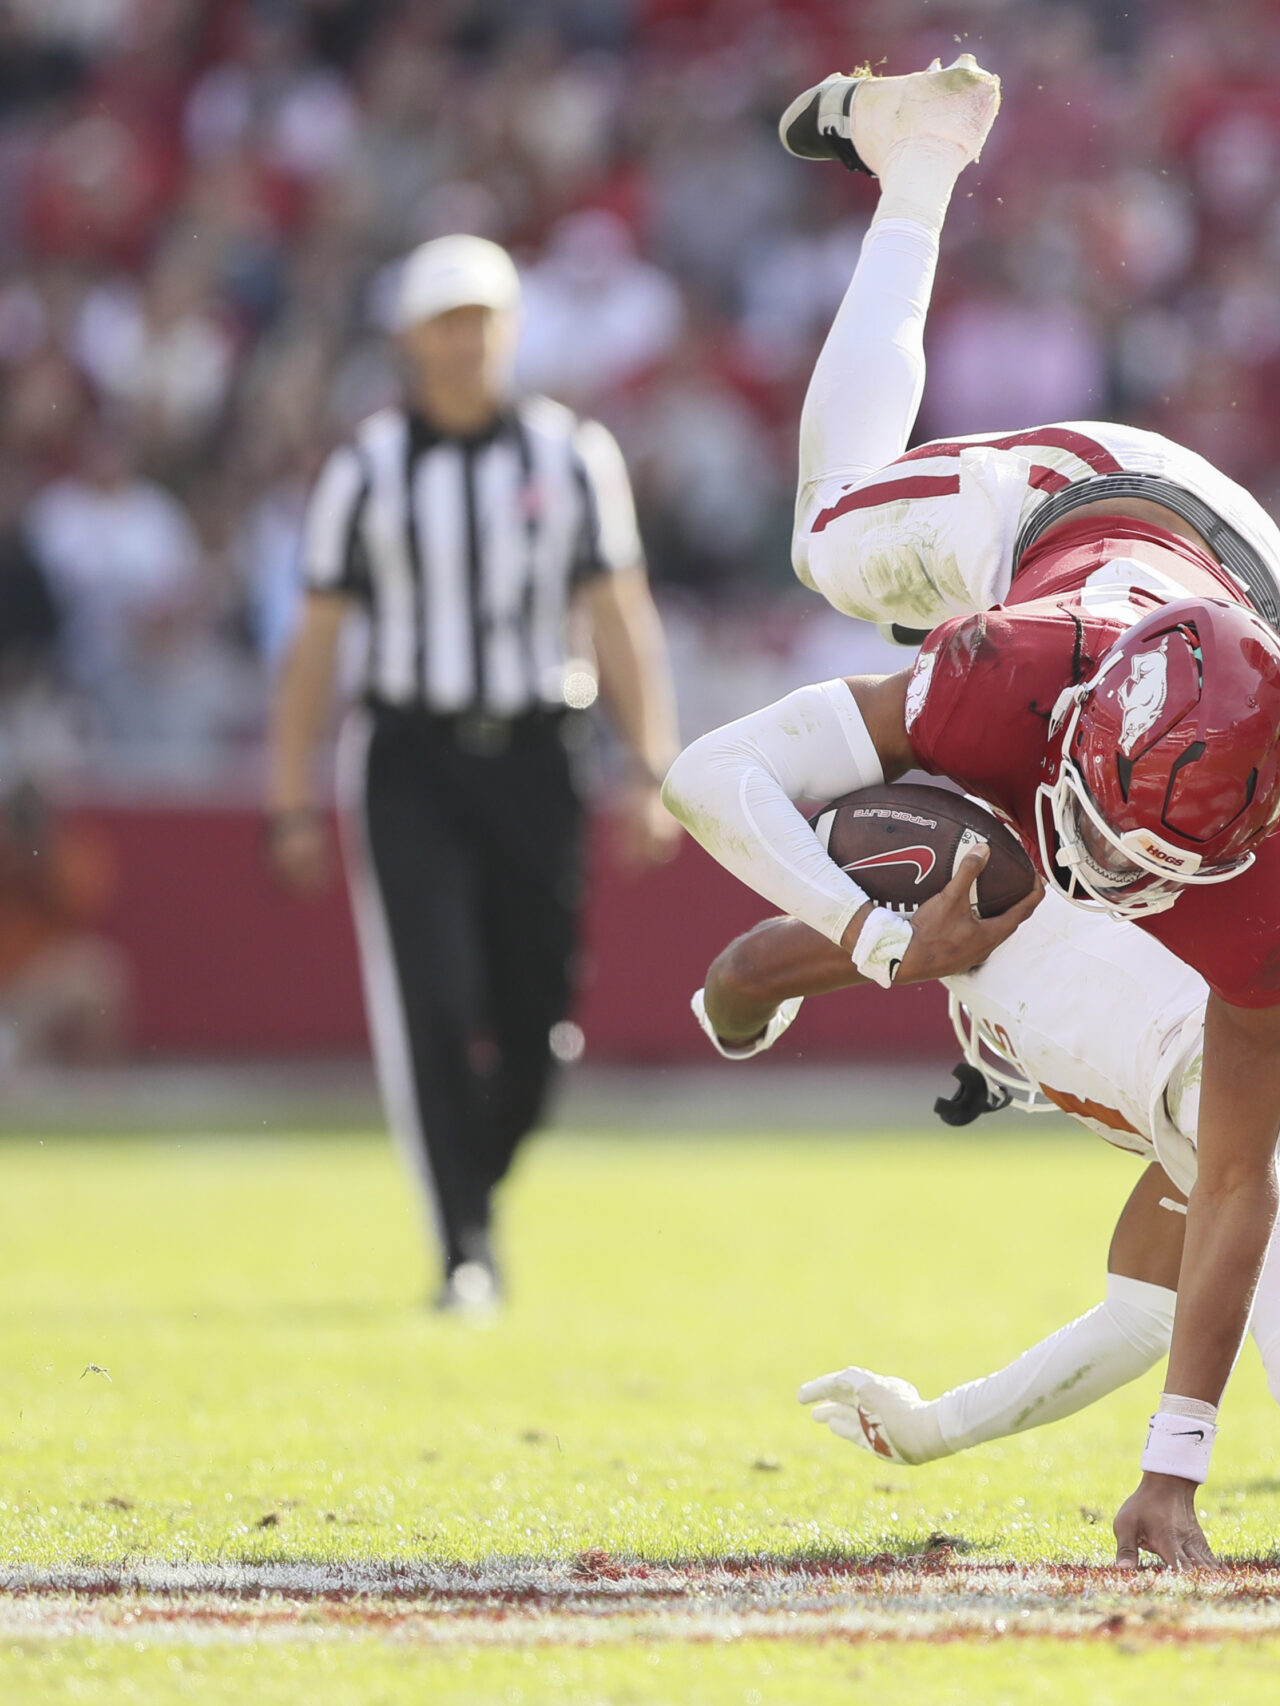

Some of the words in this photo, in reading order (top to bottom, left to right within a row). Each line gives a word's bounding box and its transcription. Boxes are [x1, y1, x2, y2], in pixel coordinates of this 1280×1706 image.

[853, 809, 891, 818] ELITE
[891, 811, 938, 829] VAPOR
[1146, 845, 1185, 866] HOGS
